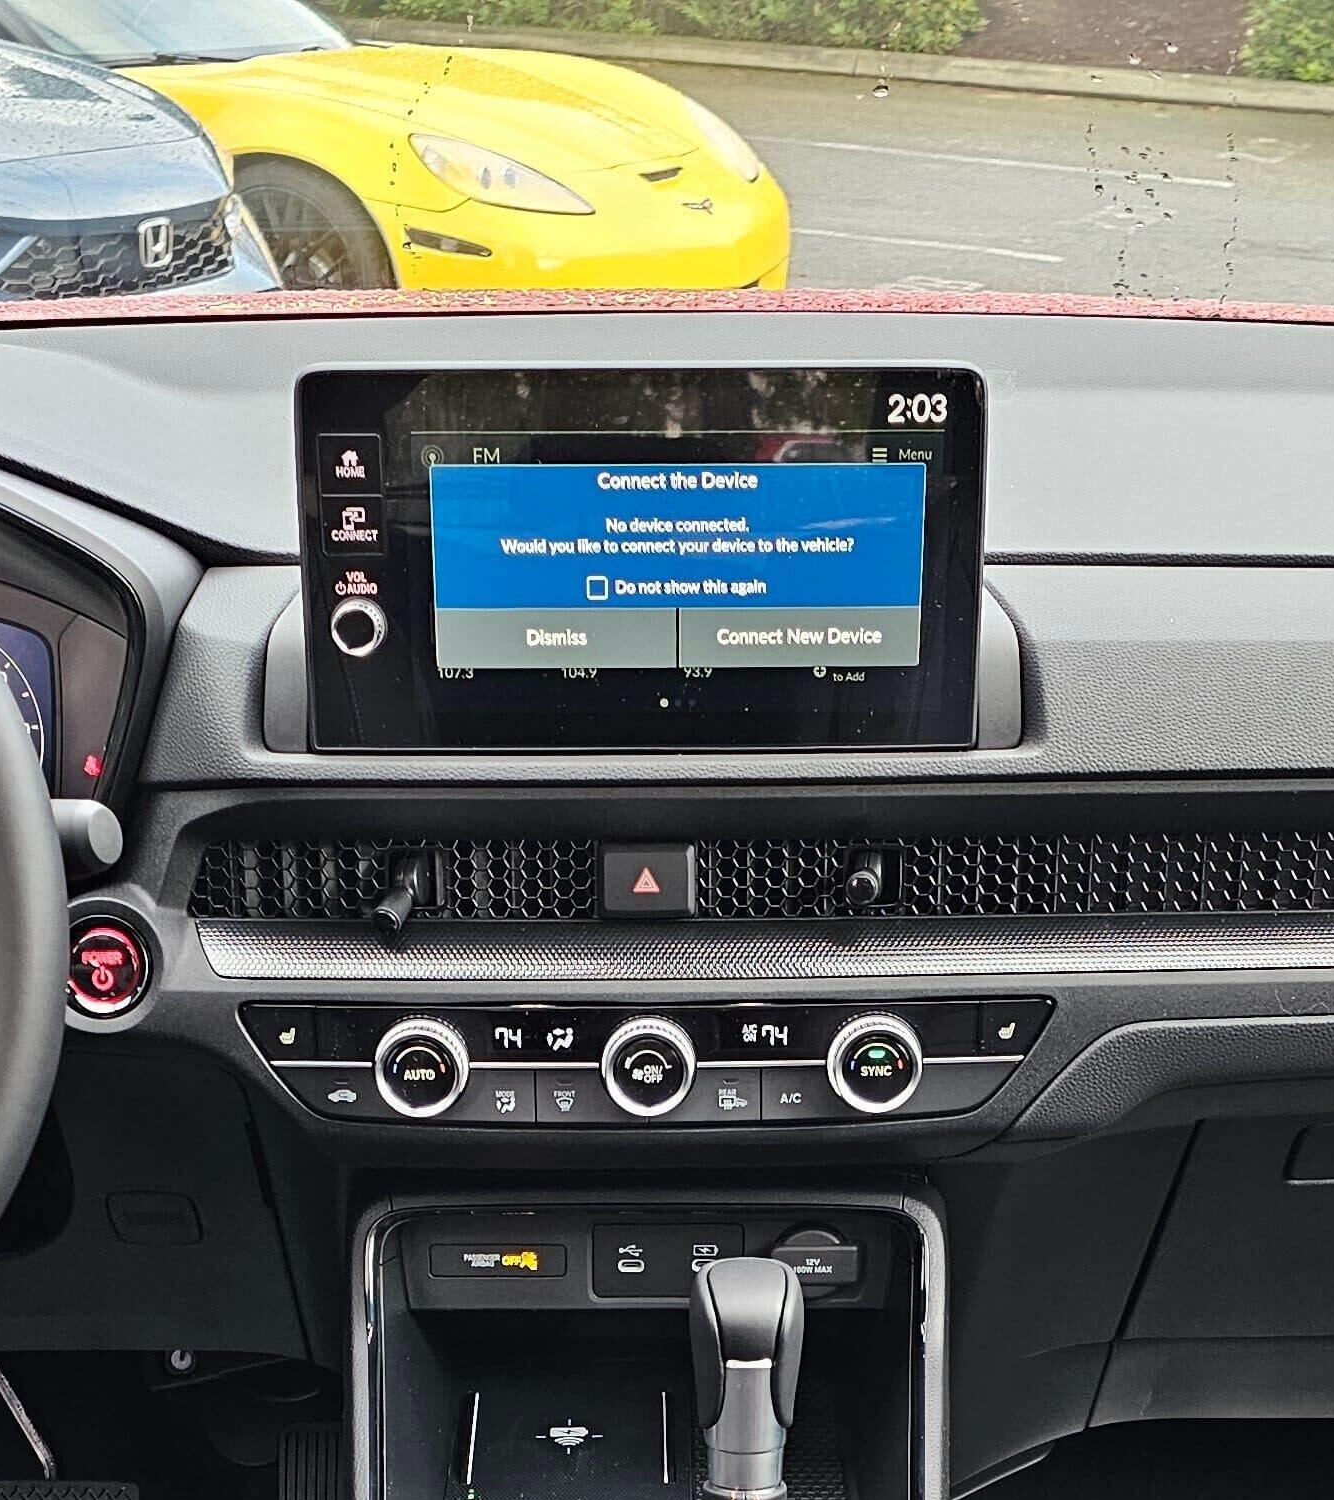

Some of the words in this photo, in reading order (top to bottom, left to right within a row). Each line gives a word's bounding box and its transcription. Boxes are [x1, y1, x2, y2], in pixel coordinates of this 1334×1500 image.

[887, 393, 948, 424] 2:03
[473, 448, 500, 464] FM
[899, 449, 932, 460] Menu
[335, 466, 365, 478] HOME
[597, 472, 667, 490] Connect
[670, 472, 697, 490] the
[701, 472, 758, 490] Device
[606, 518, 628, 533] No
[630, 517, 673, 533] device
[676, 517, 750, 533] connected.
[331, 530, 378, 541] CONNECT
[501, 539, 547, 555] Would
[549, 541, 575, 556] you
[577, 539, 601, 554] like
[603, 540, 618, 554] to
[621, 540, 675, 554] connect
[679, 539, 709, 555] your
[712, 537, 755, 553] device
[758, 538, 773, 552] to
[776, 537, 798, 552] the
[800, 537, 854, 553] vehicle?
[346, 571, 367, 582] VOL
[347, 583, 377, 595] AUDIO
[615, 580, 636, 595] Do
[639, 580, 662, 595] not
[664, 579, 700, 595] show
[703, 579, 728, 594] this
[731, 579, 767, 596] again
[526, 629, 588, 646] Dismiss
[717, 629, 783, 645] Connect
[787, 629, 824, 644] New
[827, 628, 883, 644] Device
[437, 667, 474, 679] 107.3
[561, 667, 597, 679] 104.9
[833, 672, 843, 682] to
[845, 672, 865, 682] Add
[742, 1024, 757, 1033] A/C
[495, 1027, 522, 1049] 74
[743, 1033, 757, 1042] ON
[762, 1025, 788, 1046] 74
[404, 1069, 435, 1081] AUTO
[644, 1065, 663, 1074] ON/
[860, 1065, 892, 1077] SYNC
[644, 1073, 663, 1084] OFF
[780, 1093, 802, 1104] A/C
[502, 1255, 521, 1266] OFF
